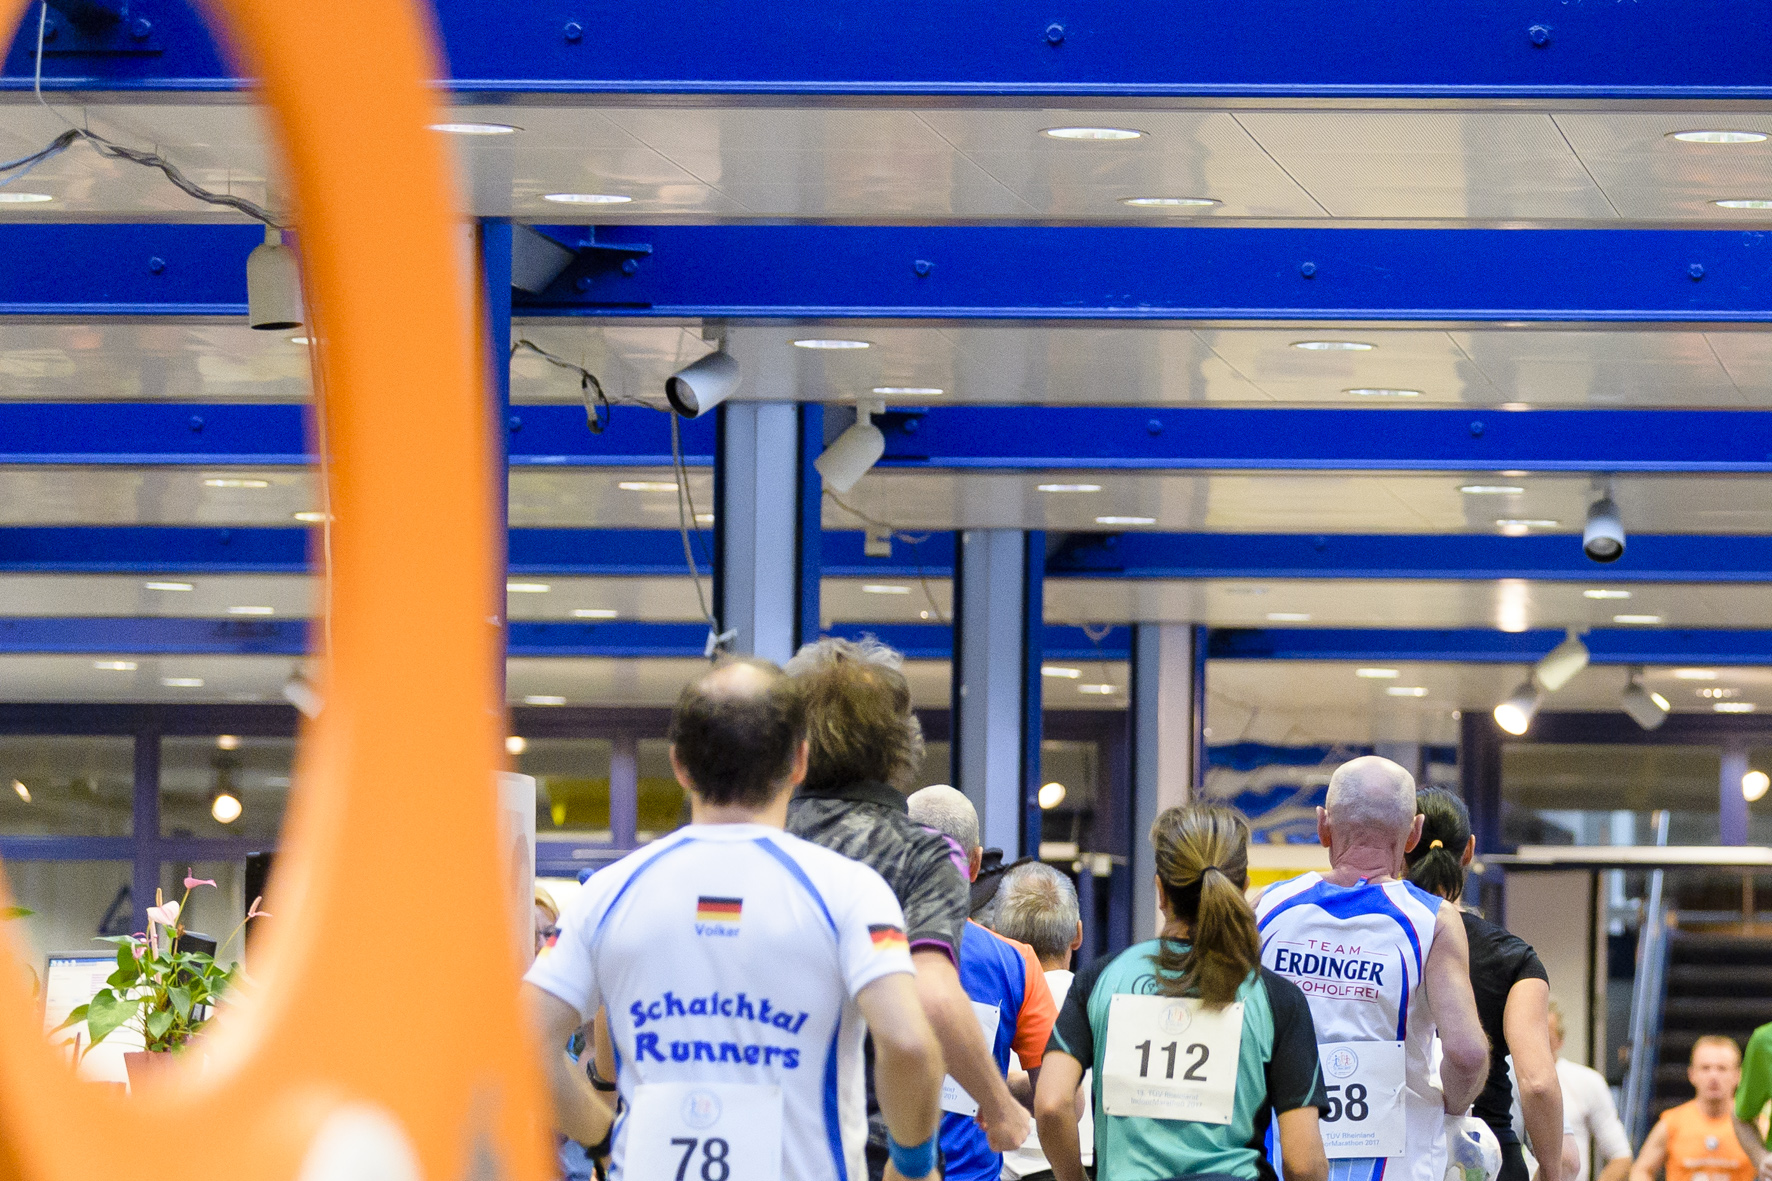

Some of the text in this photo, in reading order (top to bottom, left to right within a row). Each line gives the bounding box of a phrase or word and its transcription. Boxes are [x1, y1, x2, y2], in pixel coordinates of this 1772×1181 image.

[694, 923, 740, 937] Volker
[1308, 939, 1361, 956] TEAM
[1274, 948, 1385, 987] ERDINGER
[1293, 979, 1379, 999] KOHOLFREI
[629, 990, 809, 1035] Schaichtal
[635, 1031, 800, 1069] Runners
[1134, 1039, 1210, 1082] 112
[1320, 1083, 1369, 1123] 58
[1324, 1139, 1380, 1148] orMarathon 2017
[1326, 1132, 1340, 1140] TÜV
